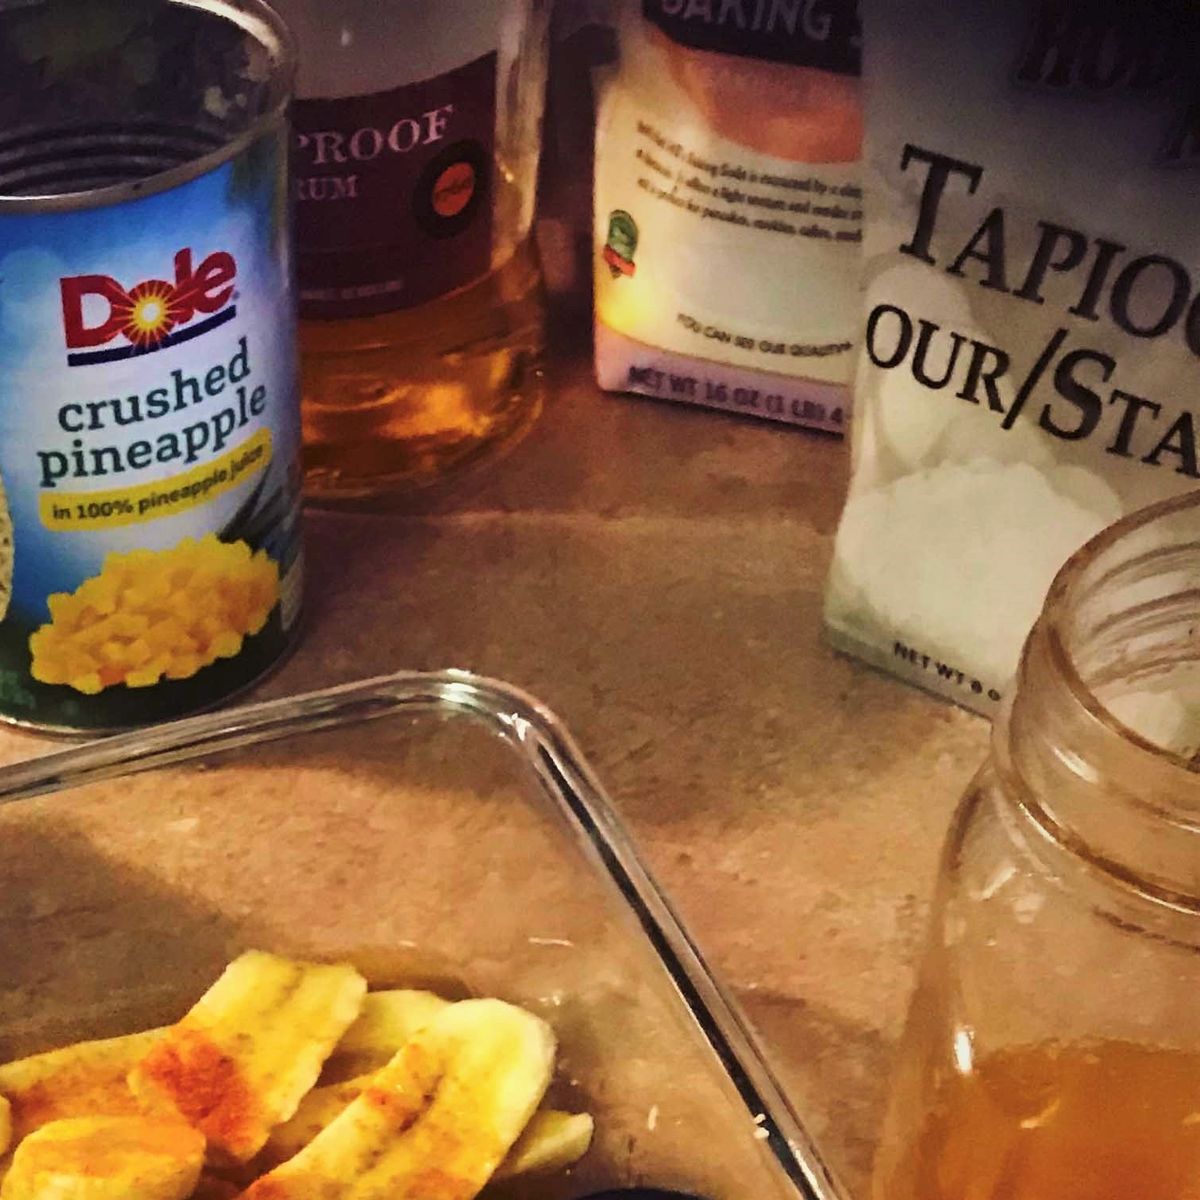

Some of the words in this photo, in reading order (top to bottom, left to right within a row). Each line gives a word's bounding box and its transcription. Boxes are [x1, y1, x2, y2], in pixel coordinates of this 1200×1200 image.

[60, 248, 237, 348] Dole
[900, 143, 1200, 358] TAPIO
[58, 335, 251, 432] crushed
[703, 326, 732, 344] CAN
[36, 384, 267, 488] pineapple
[53, 504, 71, 521] in
[77, 498, 134, 520] 100%
[138, 466, 228, 515] pineapple
[229, 444, 264, 481] juice
[894, 642, 930, 669] NET
